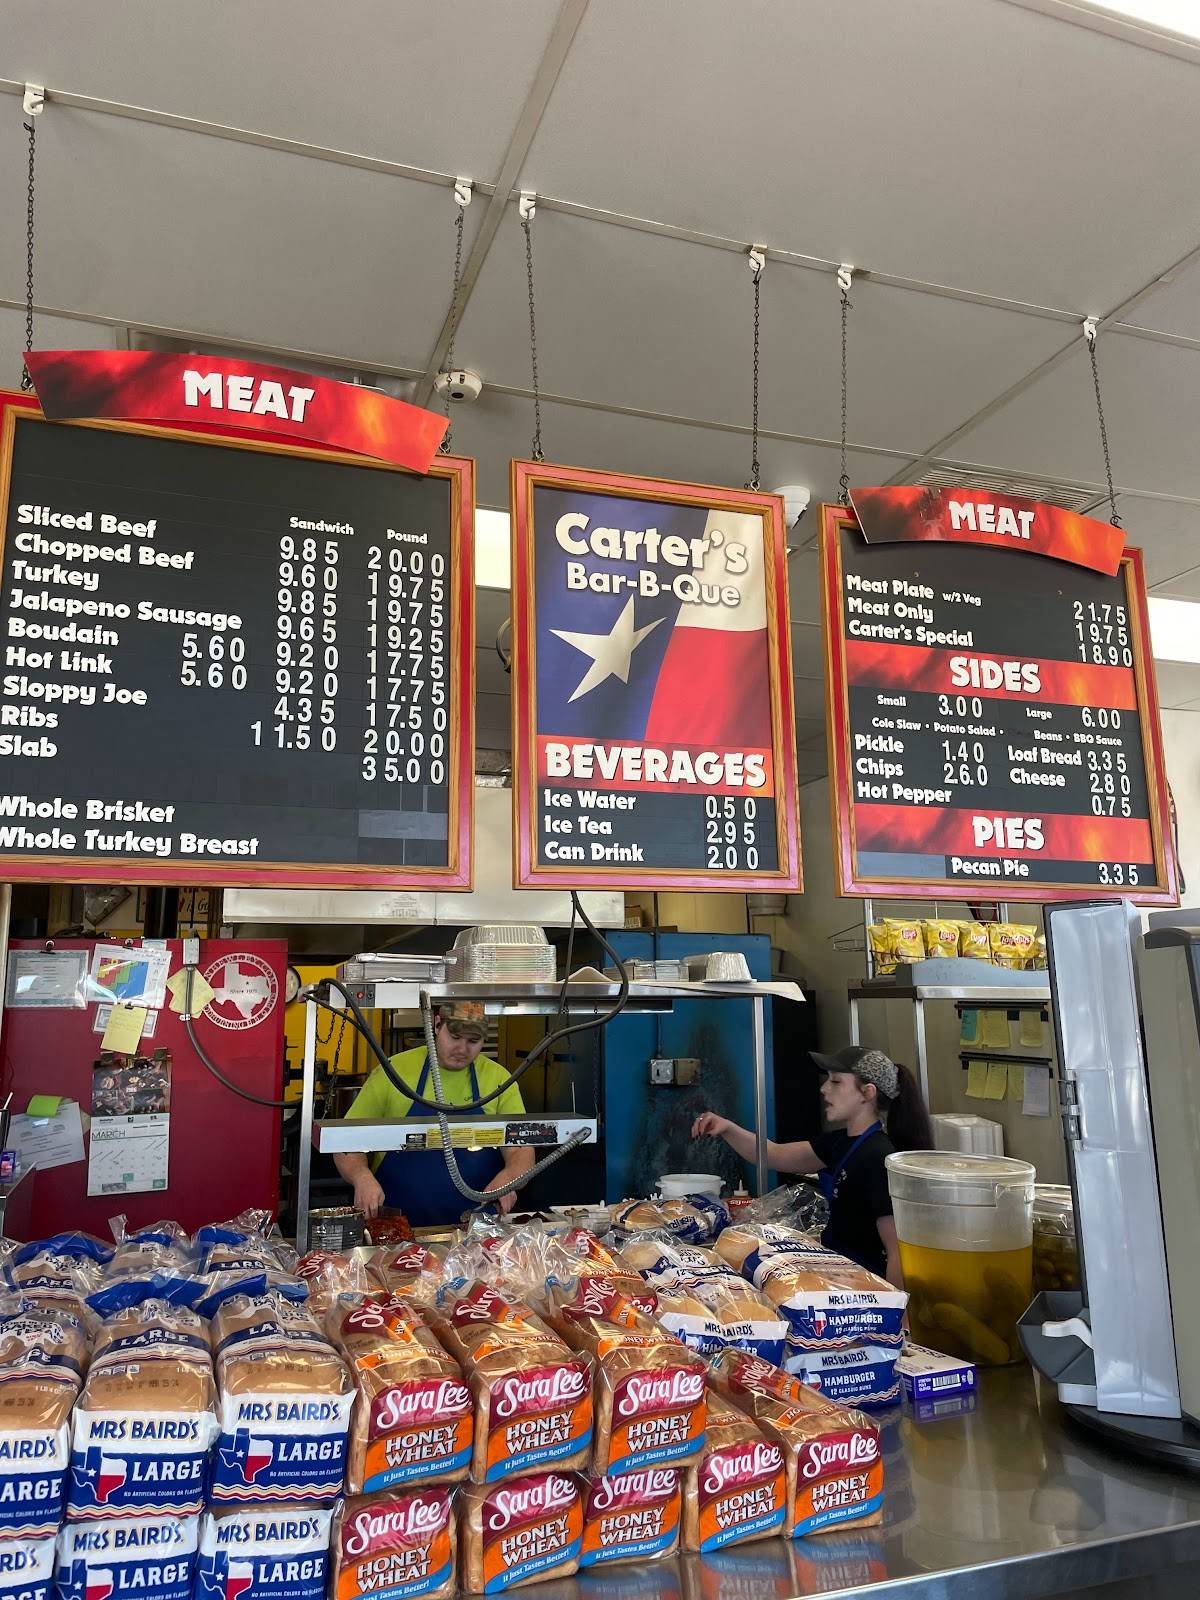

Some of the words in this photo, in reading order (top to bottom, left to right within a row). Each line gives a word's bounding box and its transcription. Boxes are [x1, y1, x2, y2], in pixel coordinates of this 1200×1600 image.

[183, 370, 314, 422] MEAT
[18, 505, 92, 530] Sliced
[100, 514, 156, 538] Beef
[290, 517, 354, 535] Sandwich
[387, 529, 427, 544] Pound
[949, 501, 1034, 539] MEAT
[15, 533, 131, 563] Chopped
[139, 546, 194, 569] Beef
[280, 536, 338, 564] 9.85
[555, 512, 748, 574] Carter's
[12, 560, 99, 591] Turkey
[280, 562, 337, 590] 9.60
[566, 562, 740, 606] Bar-B-Que
[278, 588, 336, 616] 9.85
[847, 575, 888, 593] Meat
[892, 580, 934, 599] Plate
[943, 592, 961, 602] w/2
[963, 594, 981, 606] Veg
[10, 589, 130, 618] Jalapeno
[138, 602, 242, 631] Sausage
[848, 597, 889, 616] Meat
[894, 602, 933, 623] Only
[8, 617, 119, 645] Boudain
[278, 615, 336, 643] 9.65
[849, 620, 912, 640] Carter's
[916, 626, 973, 646] Special
[6, 646, 53, 668] Hot
[61, 651, 112, 673] Link
[182, 633, 244, 662] 5.60
[277, 642, 338, 670] 9.20
[181, 661, 247, 689] 5.60
[276, 669, 338, 697] 9.20
[950, 657, 1040, 693] SIDES
[3, 676, 96, 705] Sloppy
[103, 683, 147, 705] Joe
[877, 695, 906, 706] Small
[1, 705, 58, 728] Ribs
[275, 697, 334, 724] 4.35
[1026, 708, 1052, 720] Large
[855, 734, 904, 753] Pickle
[872, 717, 894, 728] Cole
[897, 719, 921, 730] Slaw
[934, 722, 965, 733] Potato
[968, 725, 995, 736] Salad
[1034, 730, 1062, 741] Beans
[1074, 733, 1094, 743] BBQ
[1096, 735, 1122, 745] Sauce
[0, 735, 57, 757] Slab
[1008, 745, 1037, 762] Loaf
[1041, 748, 1082, 765] Bread
[545, 743, 765, 786] BEVERAGES
[856, 758, 903, 778] Chips
[1010, 768, 1065, 786] Cheese
[544, 789, 572, 807] Ice
[577, 791, 636, 809] Water
[857, 781, 888, 798] Hot
[892, 784, 952, 804] Pepper
[0, 796, 78, 818] Whole
[86, 800, 175, 822] Brisket
[545, 815, 572, 833] Ice
[578, 816, 612, 834] Tea
[972, 816, 1044, 849] PIES
[0, 827, 76, 849] Whole
[84, 829, 171, 856] Turkey
[180, 833, 259, 855] Breast
[545, 841, 585, 859] Can
[591, 843, 644, 861] Drink
[951, 857, 1001, 875] Pecan
[1003, 860, 1029, 876] Pie
[92, 1130, 125, 1139] MARCH
[829, 1295, 844, 1304] MRS
[829, 1315, 882, 1325] HAMBURGER
[822, 1356, 838, 1366] MRS
[839, 1352, 868, 1364] BAIRD'S
[824, 1372, 875, 1387] HAMBURGER
[238, 1402, 272, 1421] MRS
[277, 1401, 340, 1420] BAIRD'S
[90, 1420, 126, 1439] MRS
[132, 1418, 199, 1439] BAIRD'S
[386, 1423, 459, 1453] HONEY
[506, 1410, 574, 1441] HONEY
[628, 1412, 692, 1439] HONEY
[279, 1441, 343, 1461] LARGE
[506, 1426, 573, 1455] WHEAT
[627, 1426, 691, 1453] WHEAT
[386, 1440, 456, 1468] WHEAT
[132, 1459, 202, 1481] LARGE
[390, 1471, 405, 1482] Just
[406, 1466, 430, 1476] Tastes
[430, 1457, 455, 1470] Better!
[716, 1482, 776, 1516] HONEY
[812, 1473, 869, 1500] HONEY
[812, 1488, 869, 1512] WHEAT
[600, 1507, 665, 1533] HONEY
[716, 1496, 775, 1528] WHEAT
[74, 1530, 109, 1552] MRS
[115, 1522, 182, 1548] BAIRD'S
[217, 1523, 249, 1543] MRS
[256, 1518, 319, 1541] BAIRD'S
[501, 1515, 568, 1553] HONEY
[600, 1522, 663, 1546] WHEAT
[357, 1544, 431, 1579] HONEY
[502, 1530, 569, 1567] WHEAT
[119, 1562, 188, 1589] LARGE
[259, 1558, 324, 1583] LARGE
[357, 1559, 431, 1593] WHEAT
